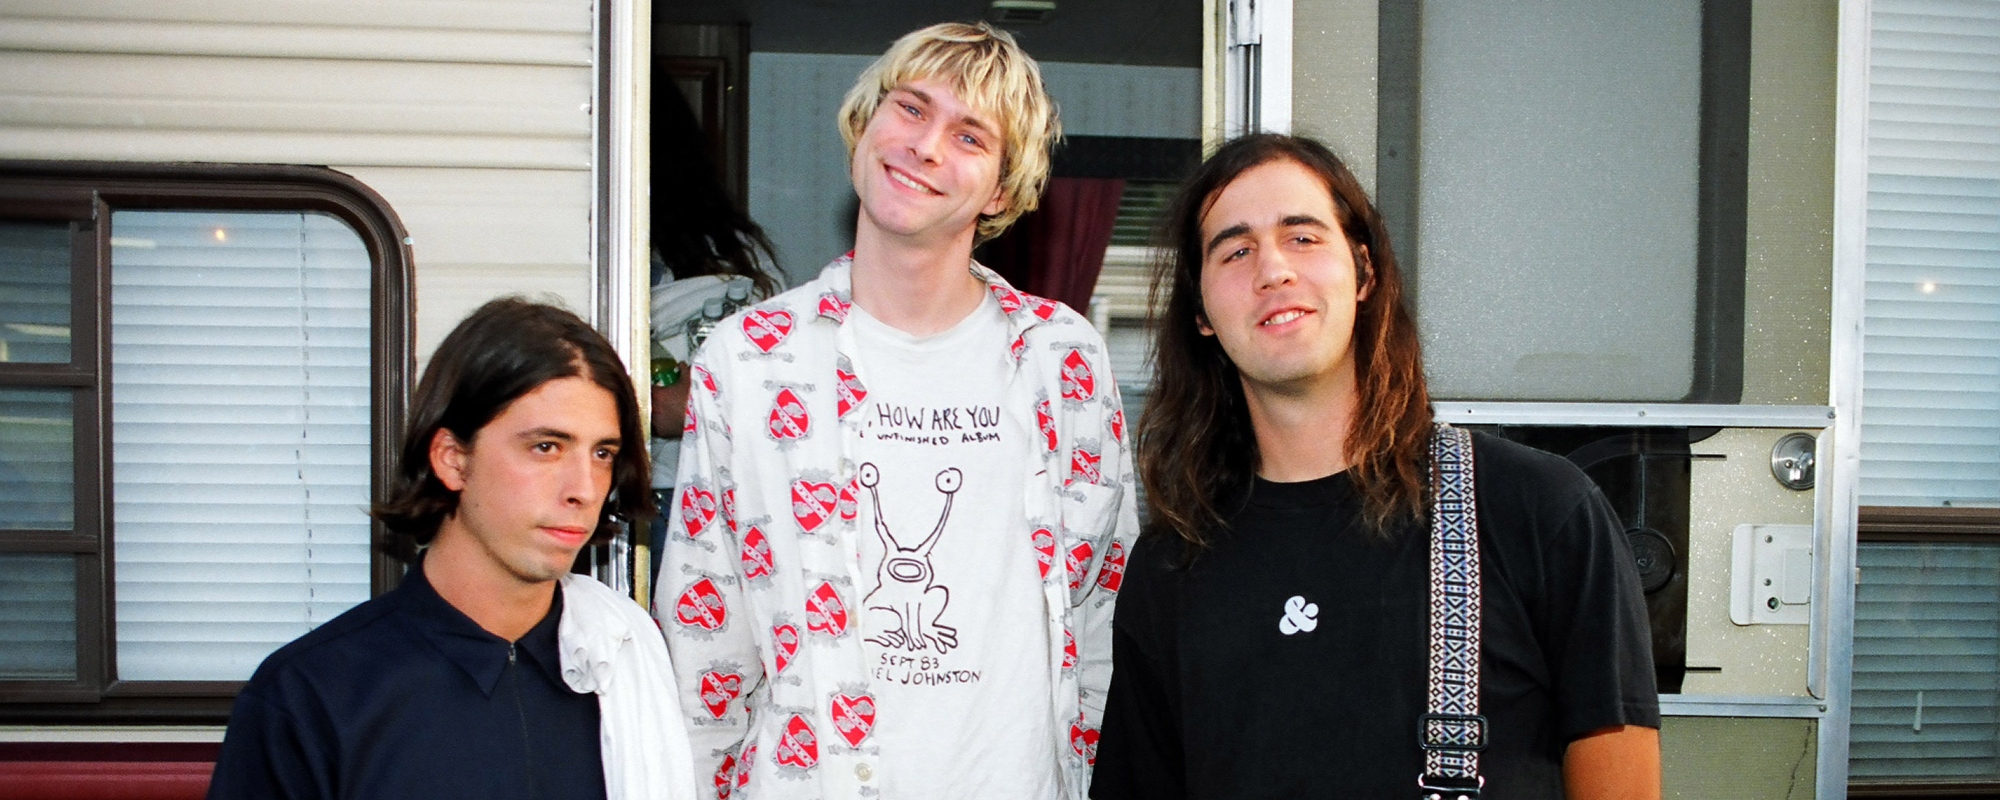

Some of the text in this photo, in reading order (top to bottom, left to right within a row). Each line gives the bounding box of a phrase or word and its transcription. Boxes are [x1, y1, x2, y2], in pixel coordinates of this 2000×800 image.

[876, 403, 1000, 431] HOW ARE YOU
[877, 432, 949, 445] UNFINISHED
[961, 432, 1001, 443] ALBUM
[881, 653, 939, 671] SEPT 83
[901, 670, 982, 686] JOHNSTON
